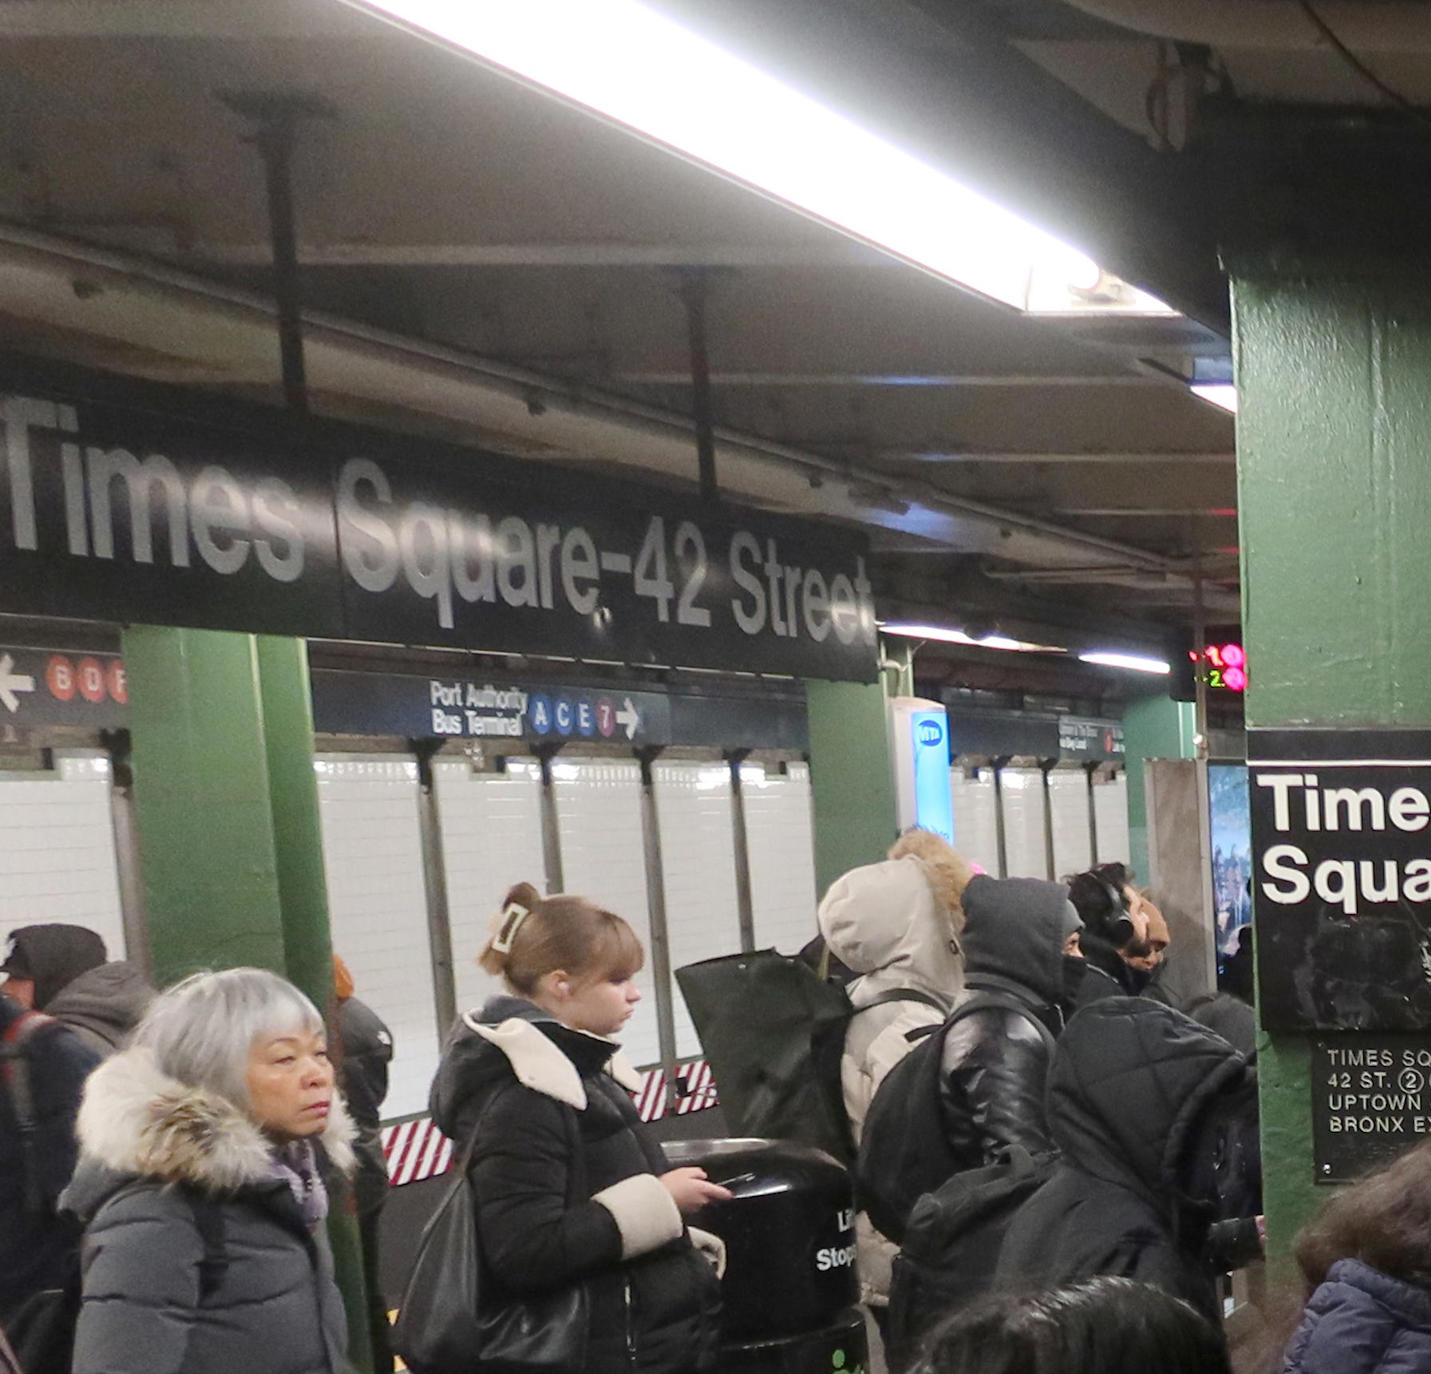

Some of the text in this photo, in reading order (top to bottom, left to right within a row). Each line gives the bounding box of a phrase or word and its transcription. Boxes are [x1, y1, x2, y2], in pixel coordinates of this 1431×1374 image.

[0, 395, 304, 582] Times
[730, 531, 876, 645] Street
[55, 665, 71, 690] B
[430, 679, 528, 715] Port Authority
[432, 708, 524, 736] Bus Terminal
[534, 701, 609, 728] A C E 7
[1328, 1050, 1394, 1067] TIMES
[1328, 1072, 1351, 1088] 42
[1360, 1071, 1392, 1089] ST.
[1329, 1094, 1421, 1111] UPTOWN
[1329, 1116, 1404, 1133] BRONX
[816, 1244, 857, 1271] Stop
